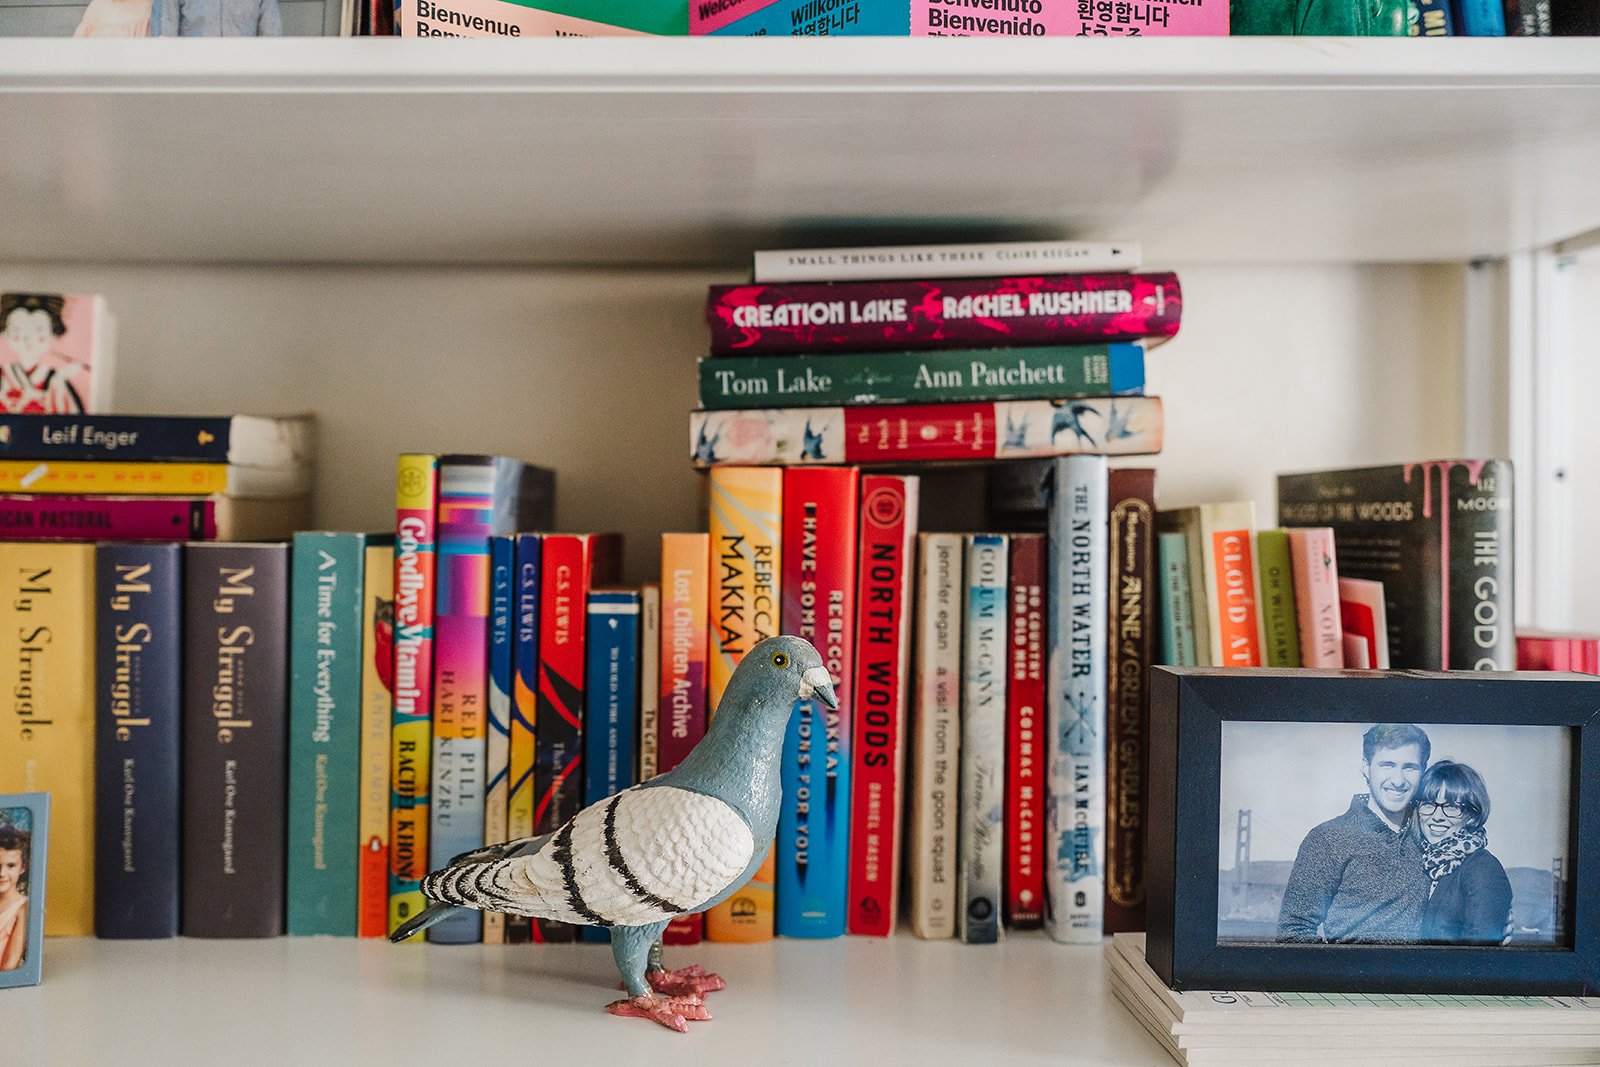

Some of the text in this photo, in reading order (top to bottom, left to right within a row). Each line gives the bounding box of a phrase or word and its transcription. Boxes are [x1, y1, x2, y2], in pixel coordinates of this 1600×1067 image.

[417, 0, 520, 37] Bienvenue
[928, 7, 1046, 36] Bienvenido
[788, 256, 836, 265] SMALL
[842, 254, 895, 265] THINGS
[901, 252, 934, 263] LIKE
[940, 251, 985, 261] THESE
[732, 302, 845, 327] CREATION
[850, 299, 908, 323] LAKE
[942, 293, 1025, 319] RACHEL
[1029, 290, 1133, 316] KUSHNER
[715, 370, 769, 396] Tom
[776, 368, 832, 395] Lake
[913, 363, 963, 389] Ann
[970, 359, 1065, 388] Patchett
[42, 424, 139, 450] Leif Enger
[1075, 486, 1089, 514] THE
[1357, 500, 1414, 521] WOODS
[801, 517, 817, 571] HAVE
[1072, 519, 1091, 596] NORTH
[1473, 530, 1498, 567] THE
[317, 572, 337, 618] Time
[720, 535, 745, 654] MAKKAI
[754, 545, 772, 645] REBECCA
[800, 581, 816, 637] SOME
[978, 548, 995, 618] COLUM
[1121, 575, 1142, 639] ANNE
[1223, 535, 1248, 624] CLOUD
[1473, 576, 1498, 649] GOD
[111, 563, 152, 742] My Struggle
[317, 622, 338, 646] for
[495, 596, 507, 645] LEWIS
[519, 594, 534, 643] LEWIS
[555, 596, 570, 645] LEWIS
[671, 568, 693, 738] Lost Children Archive
[1014, 585, 1027, 680] FOR OLD MEN
[1027, 585, 1041, 681] NO COUNTRY
[1071, 602, 1091, 679] WATER
[14, 567, 53, 742] My Struggle
[213, 567, 255, 744] My Struggle
[396, 624, 424, 714] Vitamin
[978, 627, 995, 707] McCANN
[311, 649, 337, 743] Everything
[864, 543, 896, 882] NORTH WOODS DANIEL MASON
[930, 544, 951, 883] jennifer egan a visit from the goon squad
[437, 671, 454, 828] HARI KUNZRU
[459, 694, 477, 807] RED PILL
[798, 703, 812, 766] TIONS
[826, 712, 840, 777] AKKAI
[398, 741, 416, 813] RACHEL
[796, 775, 810, 814] FOR
[1019, 706, 1034, 876] CORMAC McCARTHY
[1074, 764, 1089, 793] IAN
[796, 825, 809, 865] YOU
[1073, 798, 1089, 875] McGUIRE
